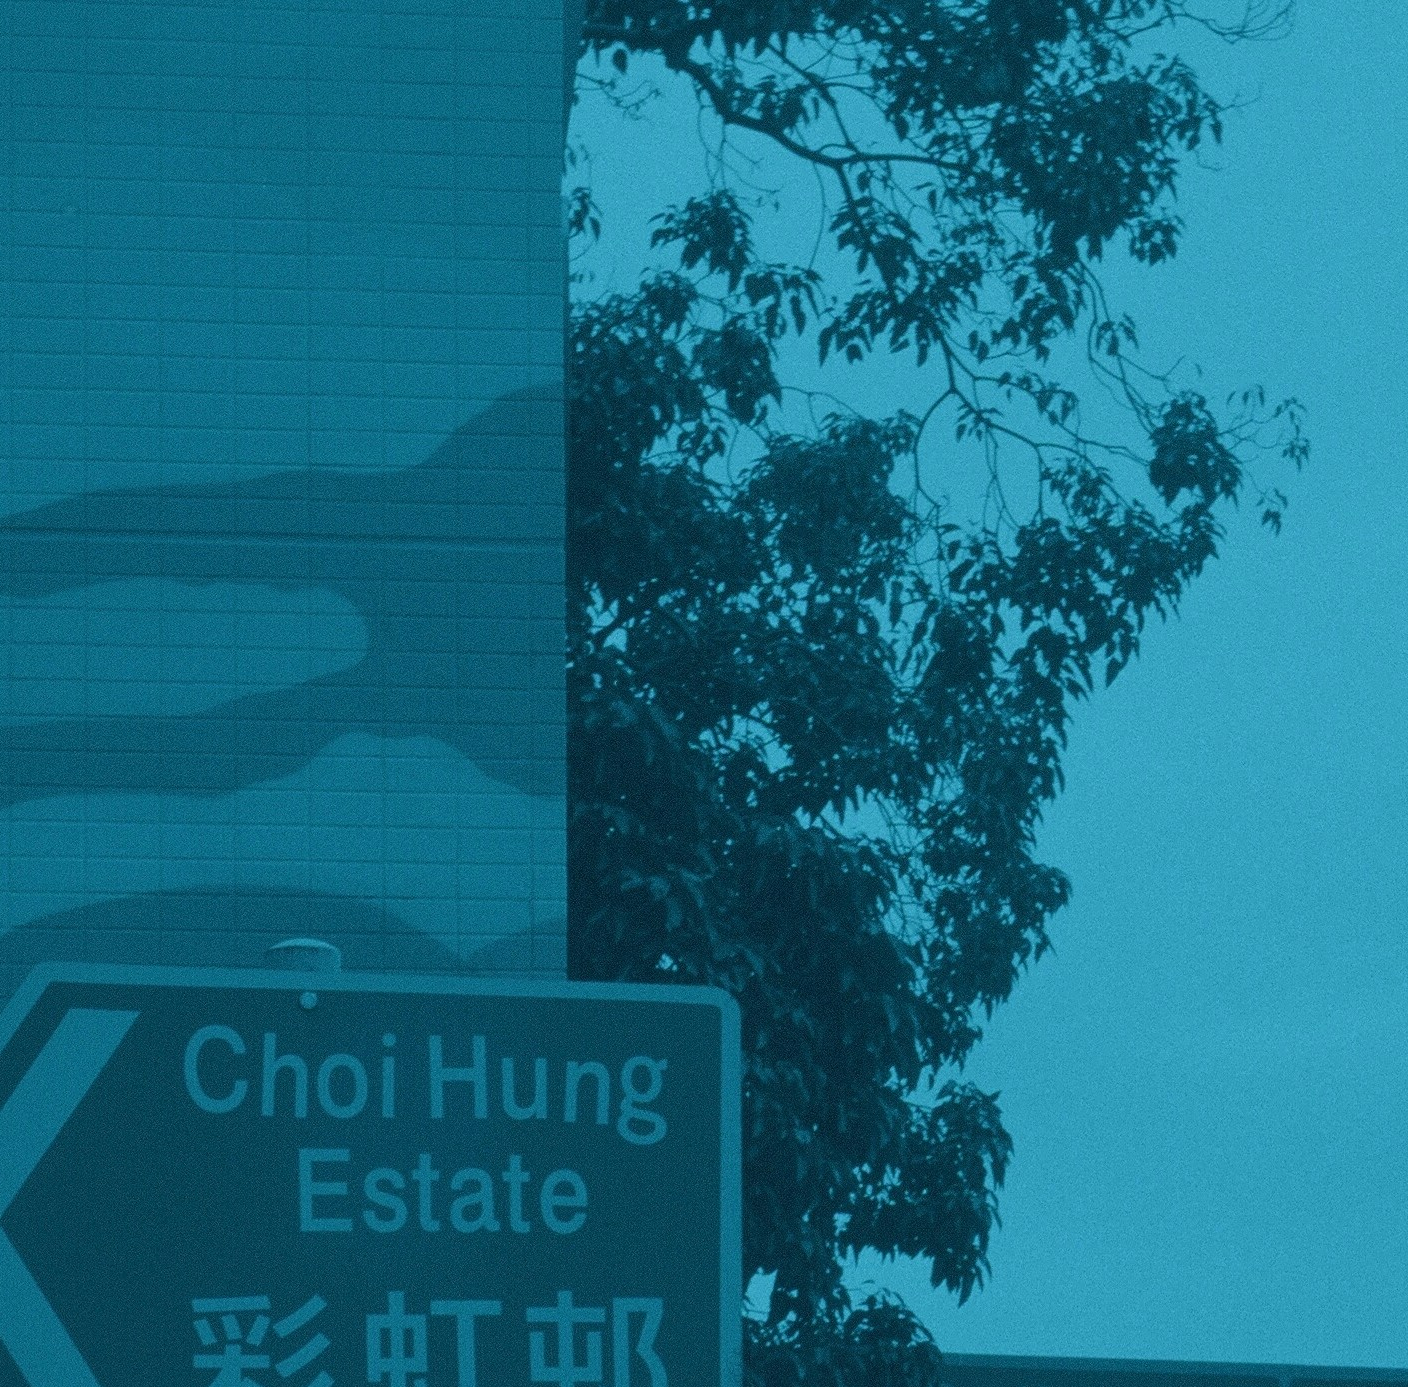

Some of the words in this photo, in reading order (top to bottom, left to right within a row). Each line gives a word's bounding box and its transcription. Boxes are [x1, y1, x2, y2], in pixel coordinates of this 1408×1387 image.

[185, 1025, 396, 1118] Choi
[429, 1035, 667, 1144] Hung
[299, 1149, 587, 1233] Estate
